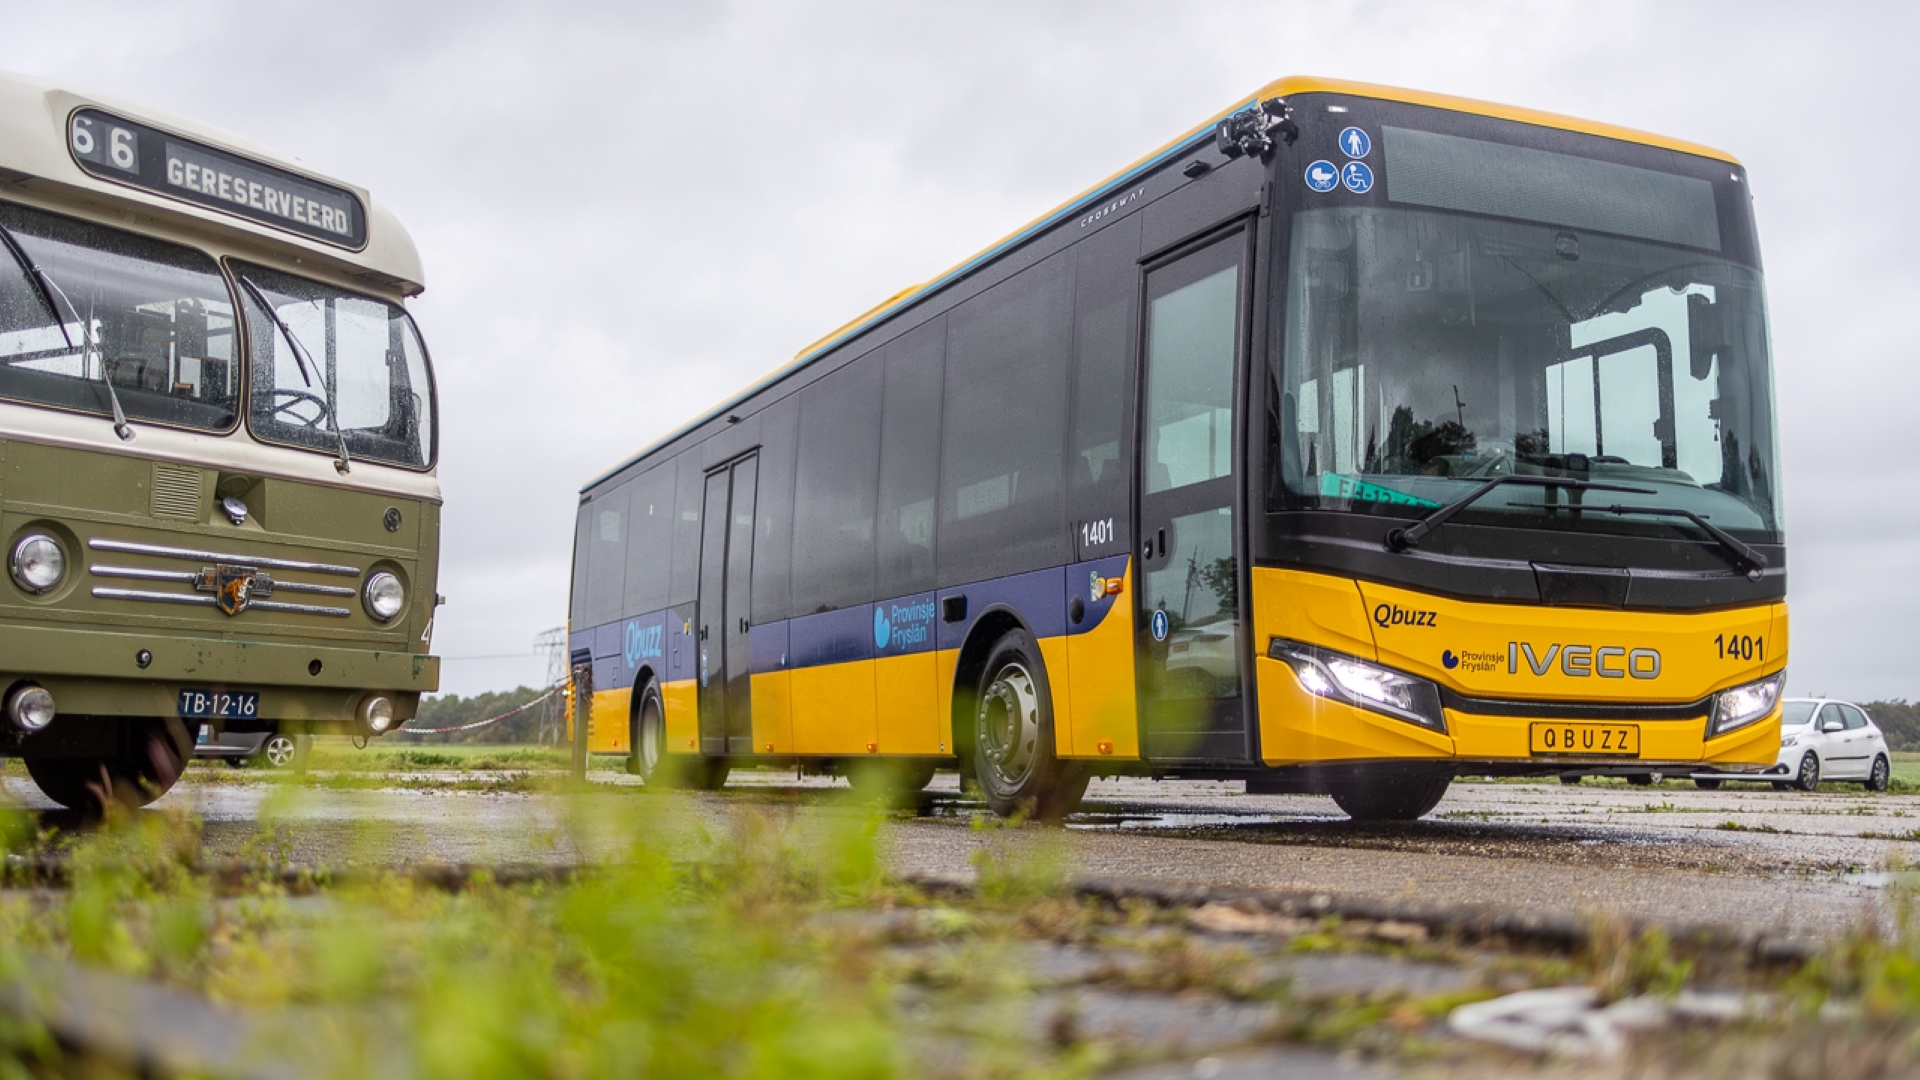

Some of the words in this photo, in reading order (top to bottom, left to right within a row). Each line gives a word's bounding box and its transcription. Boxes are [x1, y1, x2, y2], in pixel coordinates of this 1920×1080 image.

[167, 158, 348, 233] GERESERVEERD
[1080, 186, 1145, 227] CROSSWAY
[1082, 517, 1114, 547] 1401
[891, 598, 935, 625] Provinsje
[1374, 603, 1437, 628] Qbuzz
[625, 620, 662, 670] Qbuzz
[891, 623, 927, 651] Fryslân
[1713, 633, 1763, 662] 1401
[1461, 650, 1504, 665] Provinsje
[1508, 641, 1661, 680] IVECO
[183, 692, 255, 715] TB-12-16
[1544, 728, 1628, 750] QBUZZ
